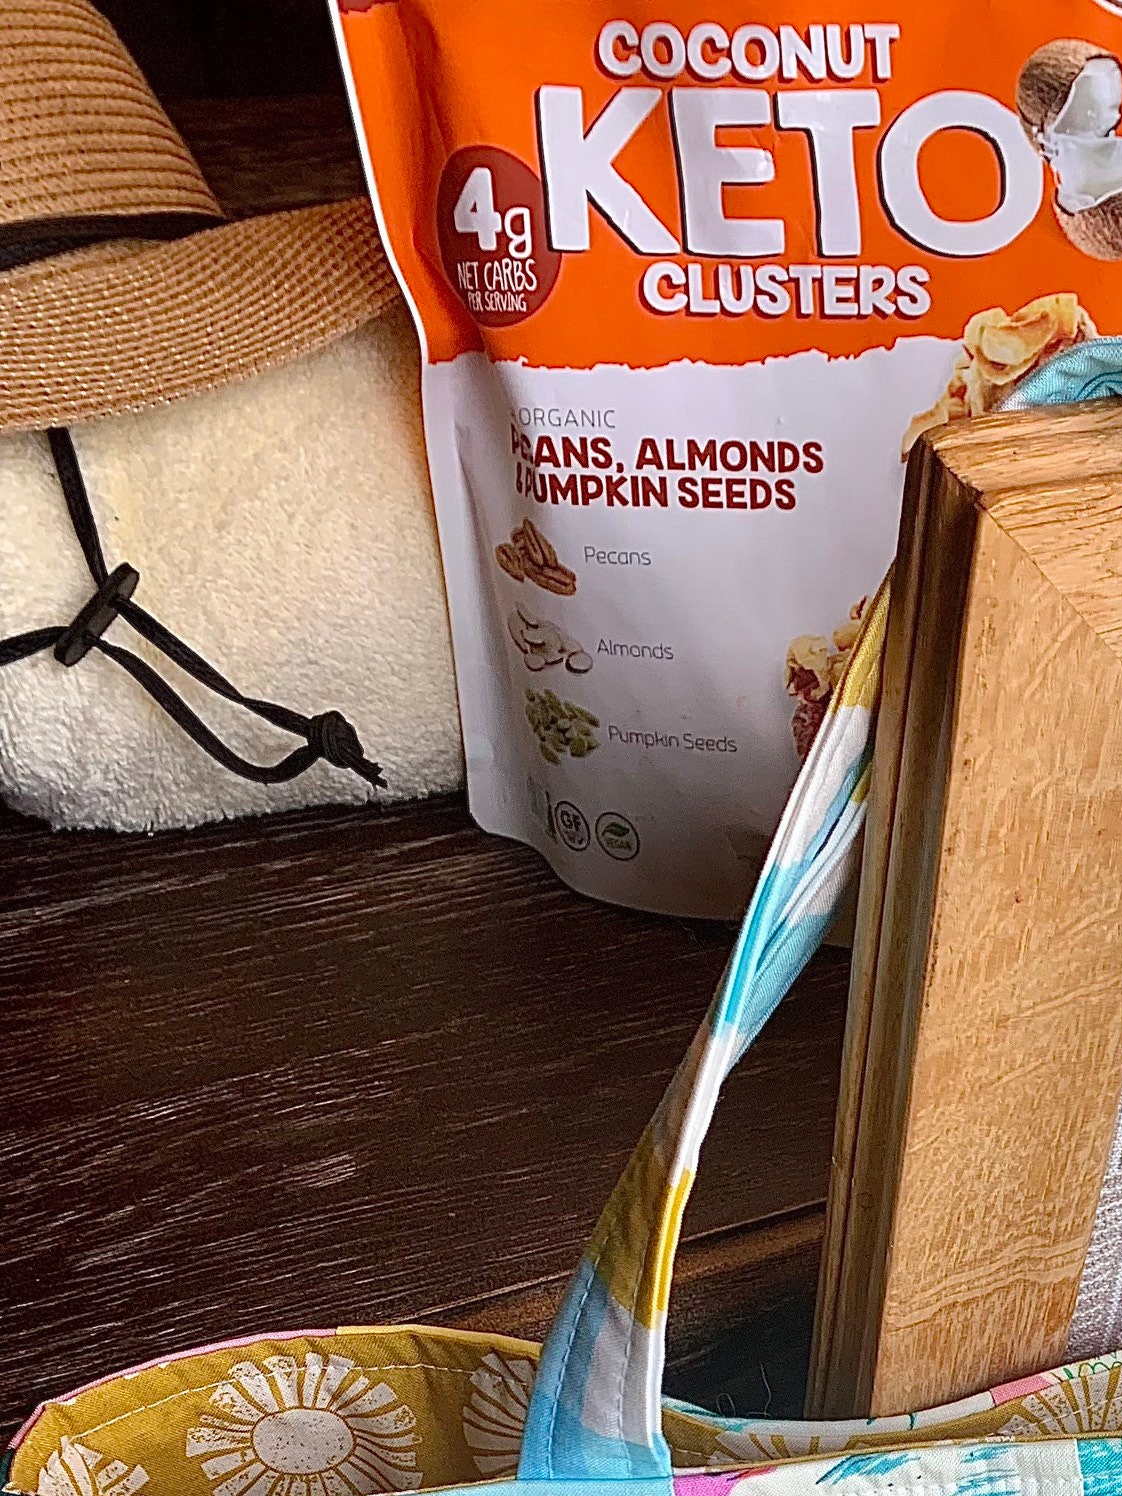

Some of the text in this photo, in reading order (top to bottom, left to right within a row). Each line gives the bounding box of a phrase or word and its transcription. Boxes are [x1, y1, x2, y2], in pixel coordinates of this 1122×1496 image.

[596, 19, 900, 82] COCONUT
[535, 86, 1043, 256] KETO
[453, 166, 533, 259] 4g
[457, 257, 537, 292] NET CARBS
[642, 263, 930, 316] CLUSTERS
[468, 291, 527, 312] PER SERVING
[519, 407, 616, 429] ORGANIC
[636, 437, 824, 474] ALMONDS
[525, 466, 668, 507] PUMPKIN
[677, 476, 796, 510] SEEDS
[584, 545, 652, 566] Pecans
[597, 638, 674, 660] Almonds
[608, 725, 738, 752] Pumpkin Seeds
